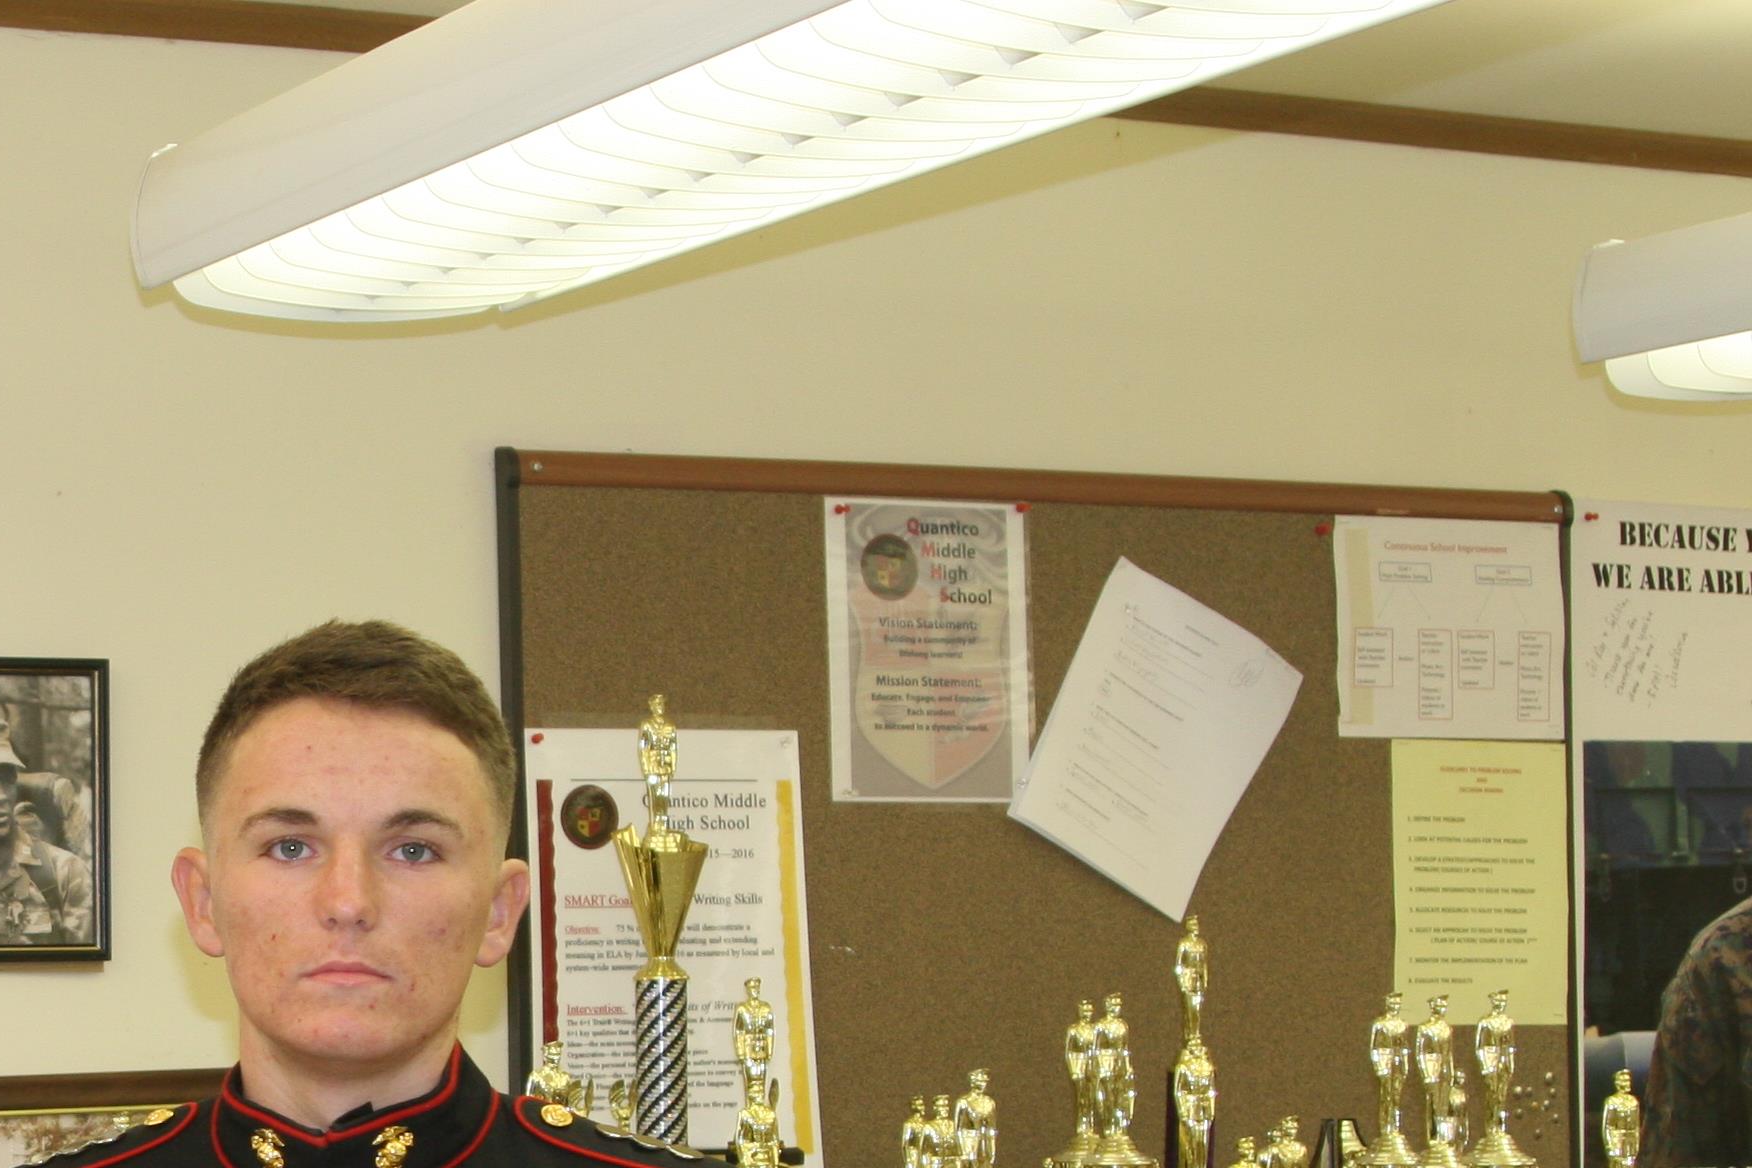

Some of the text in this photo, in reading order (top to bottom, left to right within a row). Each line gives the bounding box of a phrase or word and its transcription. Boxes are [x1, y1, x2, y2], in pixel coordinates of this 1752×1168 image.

[907, 517, 979, 537] Quantico
[1619, 521, 1737, 553] BECAUSE
[920, 542, 976, 560] Middle
[930, 565, 968, 584] High
[1592, 562, 1752, 595] WE ARE ABL
[939, 587, 992, 605] School
[879, 616, 978, 630] Vision Statement:
[876, 675, 982, 688] Mission Statement:
[714, 792, 767, 809] Middle
[699, 815, 750, 830] School
[564, 893, 763, 907] SMART Goa Writing Skills
[566, 1003, 626, 1017] Intervention:
